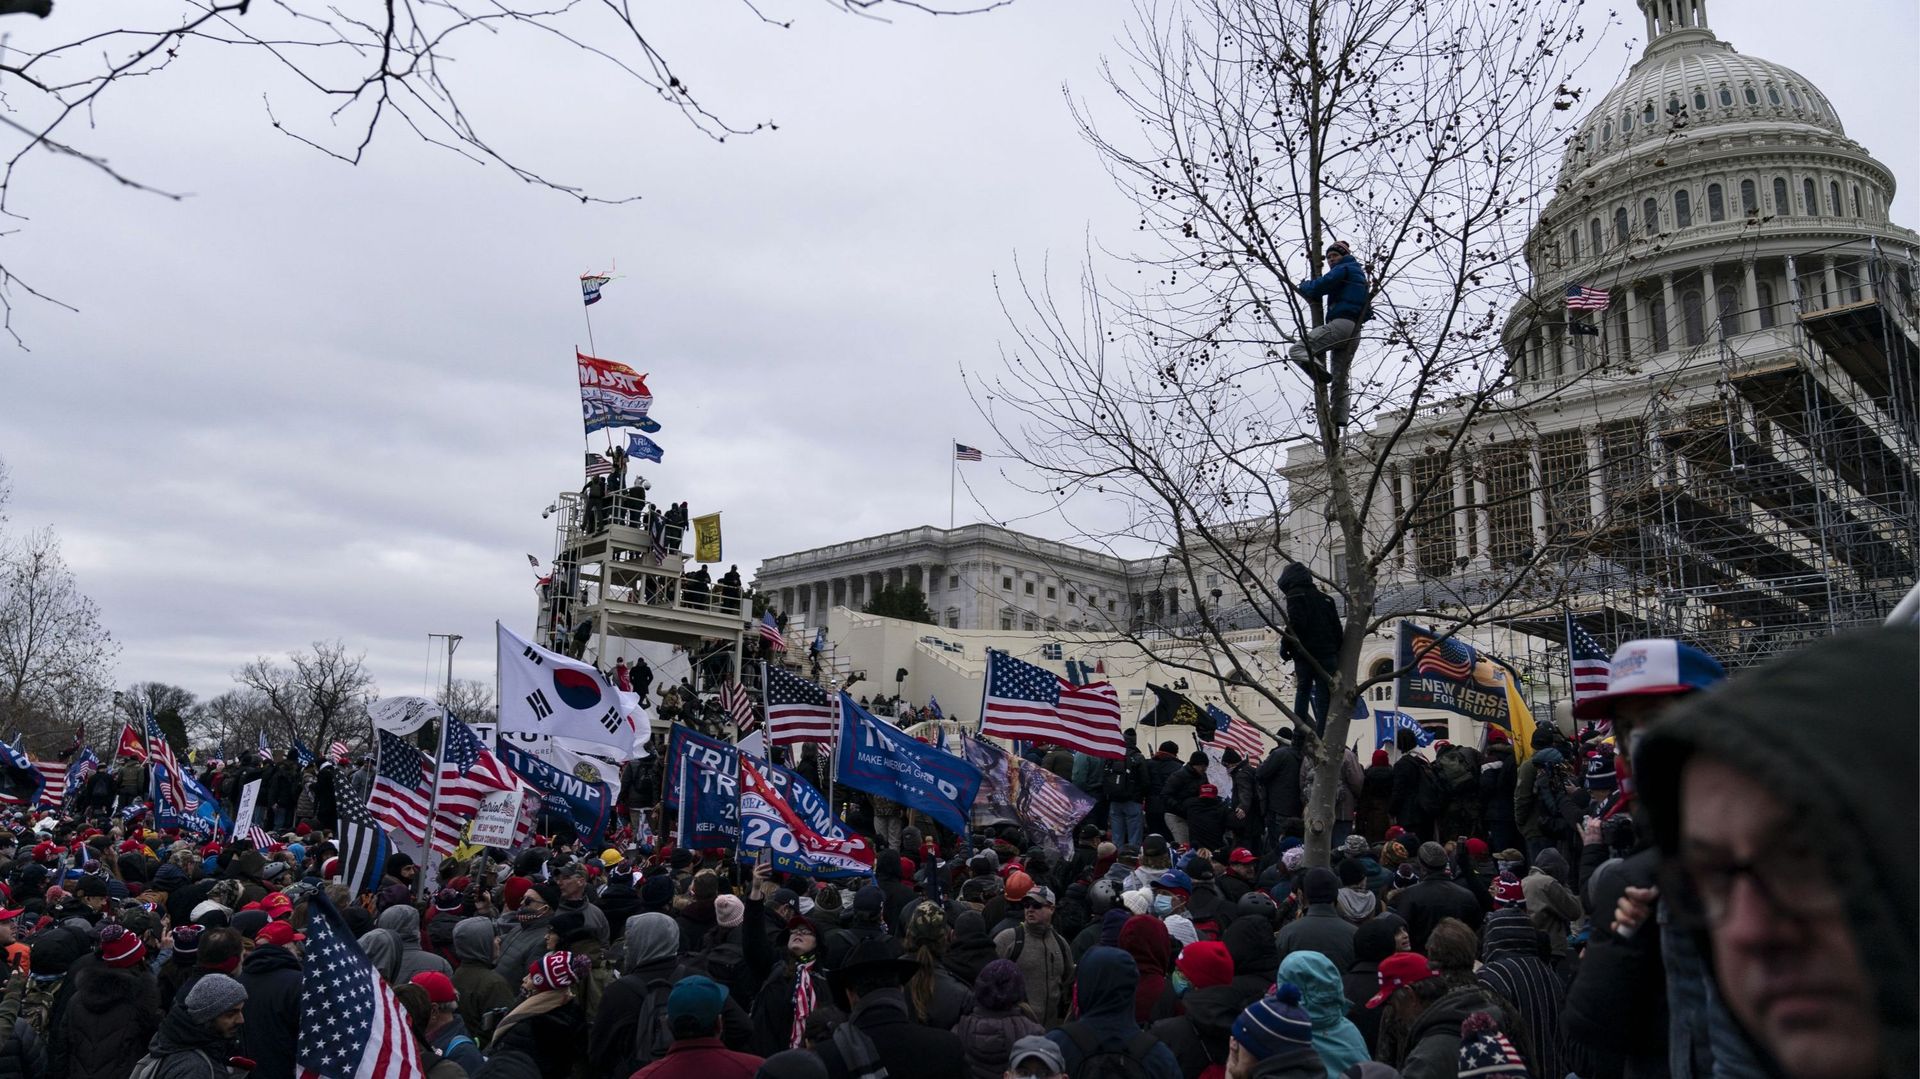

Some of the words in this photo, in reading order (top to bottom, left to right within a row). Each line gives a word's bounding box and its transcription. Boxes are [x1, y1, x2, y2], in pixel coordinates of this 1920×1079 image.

[1422, 678, 1455, 694] NEW
[1457, 685, 1508, 711] JERSE
[1433, 692, 1456, 707] FOR
[1457, 700, 1507, 719] TRUMP
[1384, 715, 1428, 742] TRUMP
[858, 752, 883, 766] MAKE
[480, 799, 503, 813] Patriot
[791, 782, 845, 840] RUMP
[778, 857, 790, 866] Of
